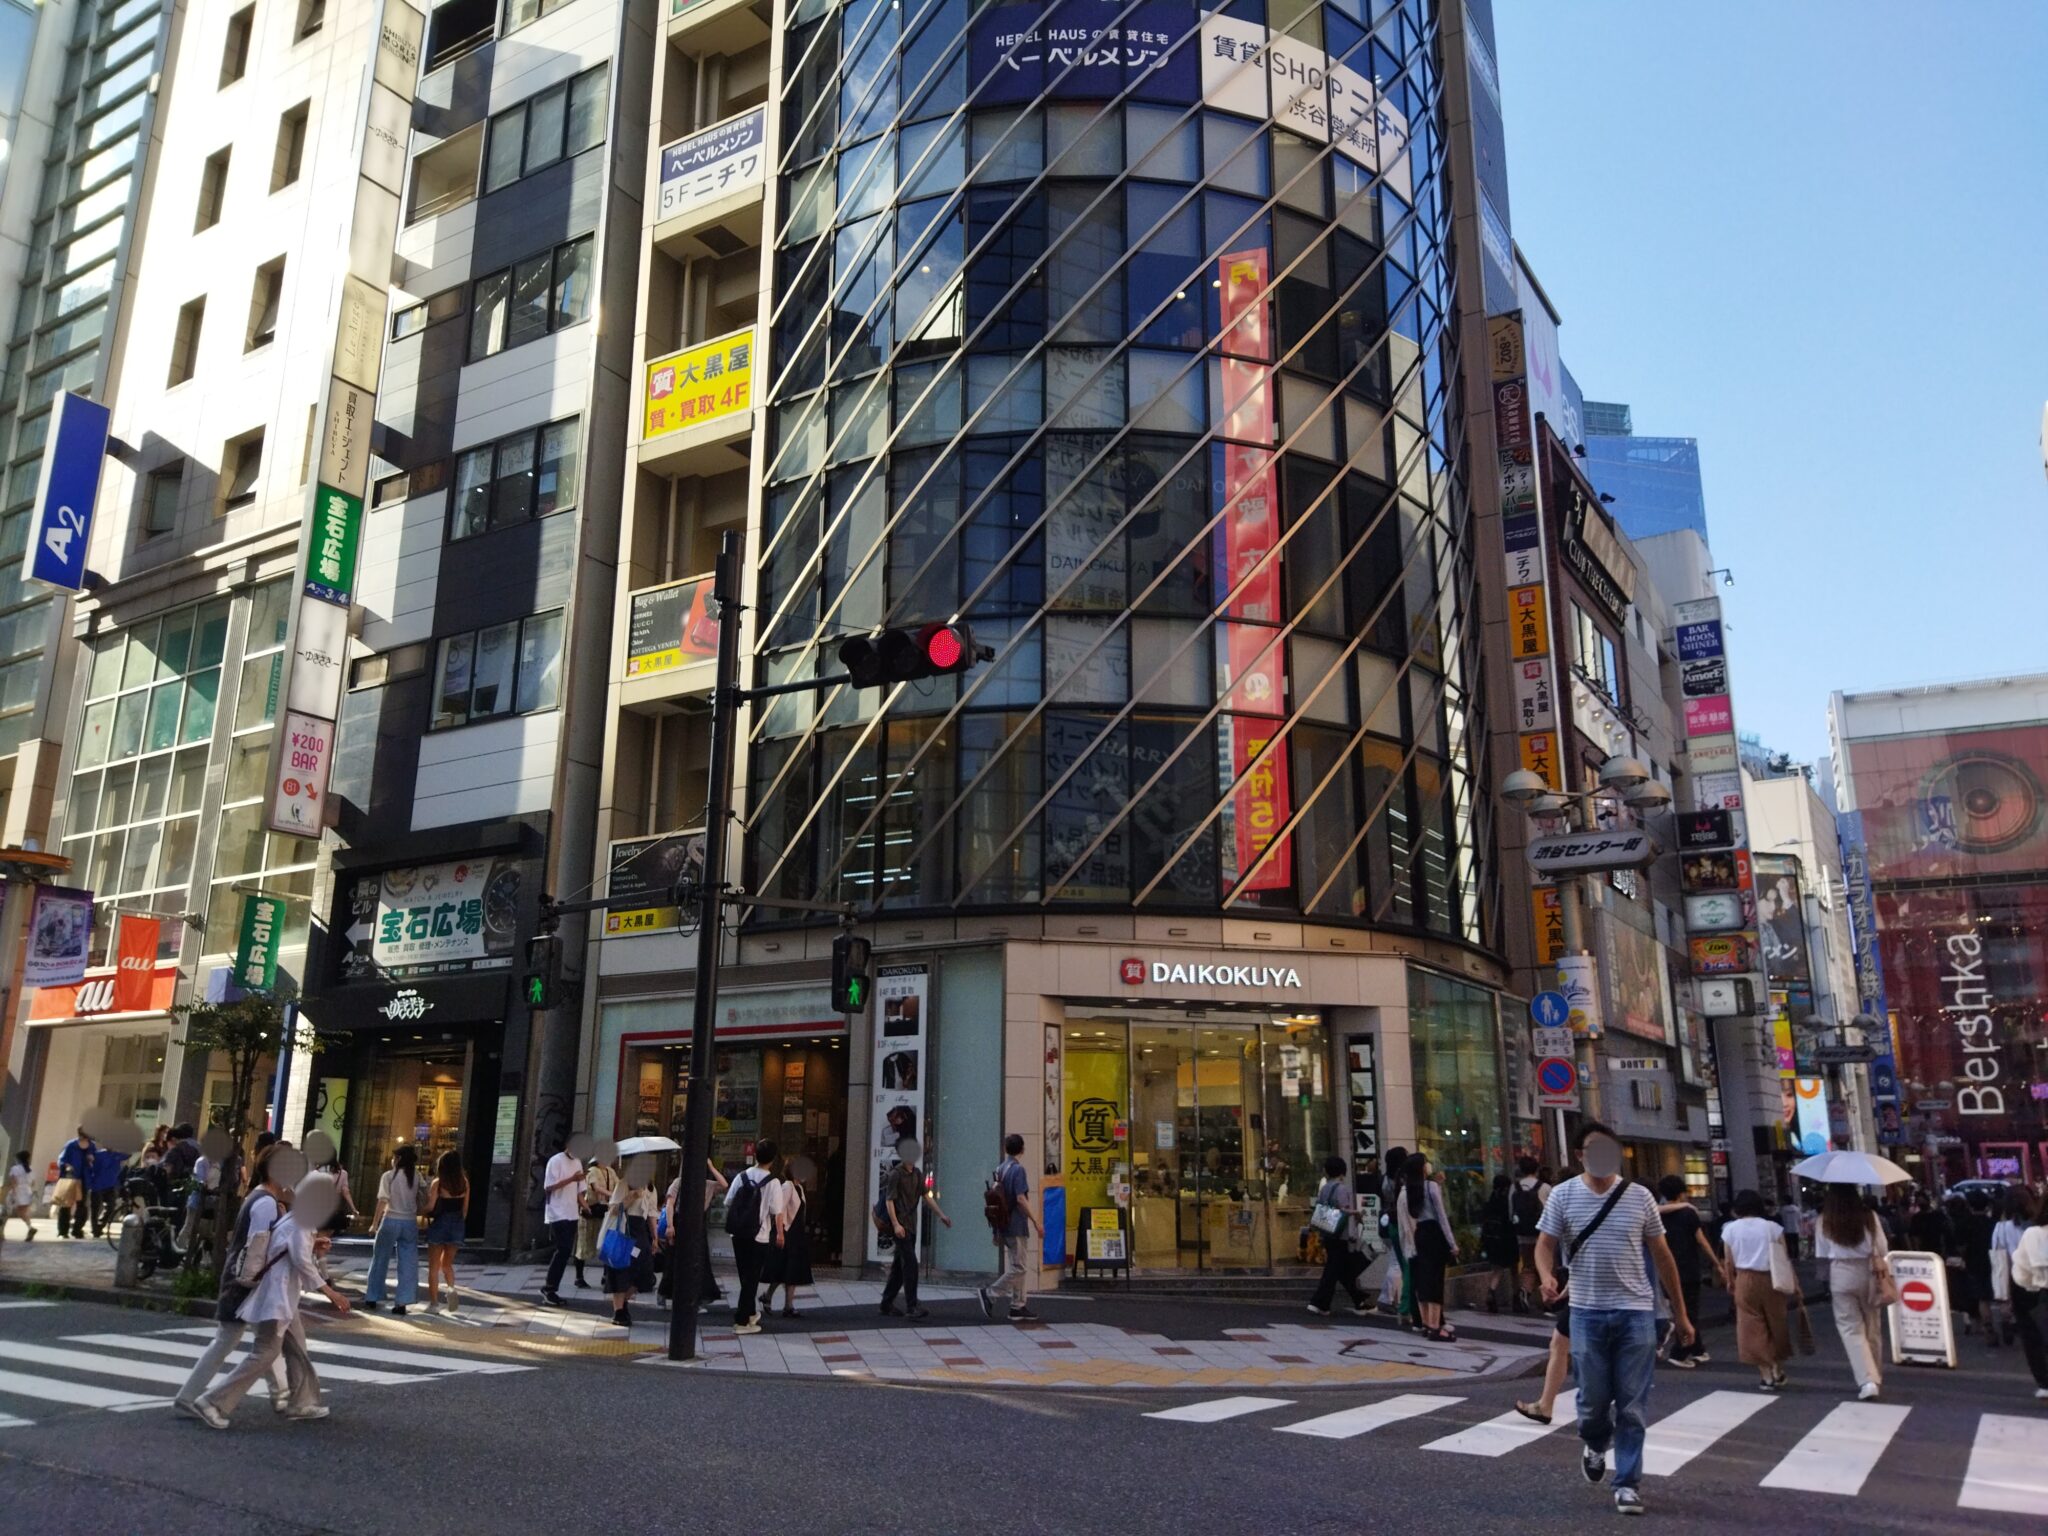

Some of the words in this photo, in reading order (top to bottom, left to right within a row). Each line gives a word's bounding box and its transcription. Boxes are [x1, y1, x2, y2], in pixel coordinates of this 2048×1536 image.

[382, 33, 416, 60] MORIS
[383, 26, 416, 52] SHIBUYA
[1048, 29, 1087, 40] HAUS
[1213, 34, 1264, 69] 賃貸
[1272, 52, 1343, 99] SHOP
[1350, 88, 1408, 152] ニチワ
[1288, 94, 1377, 158] 渋谷営業所
[671, 130, 753, 173] ヘーベルメゾン
[680, 344, 749, 389] 大黒屋
[45, 505, 85, 565] A2
[318, 495, 349, 582] 宝石広場
[1519, 608, 1538, 653] 大黒屋
[1681, 638, 1720, 652] SHINER
[1683, 631, 1716, 644] MOON
[1687, 624, 1710, 635] BAR
[1536, 680, 1549, 713] 大黒屋
[1523, 698, 1535, 728] 買取り
[292, 732, 324, 753] ¥200
[291, 751, 318, 772] BAR
[1533, 838, 1643, 860] 渋谷センター街
[379, 899, 483, 944] 宝石広場
[624, 913, 654, 928] 大黒屋
[245, 901, 275, 986] 宝石広場
[121, 955, 154, 971] au
[1152, 961, 1302, 988] DAIKOKUYA
[74, 980, 115, 1013] au
[1940, 933, 2006, 1115] Bershka
[1077, 1107, 1111, 1144] 質
